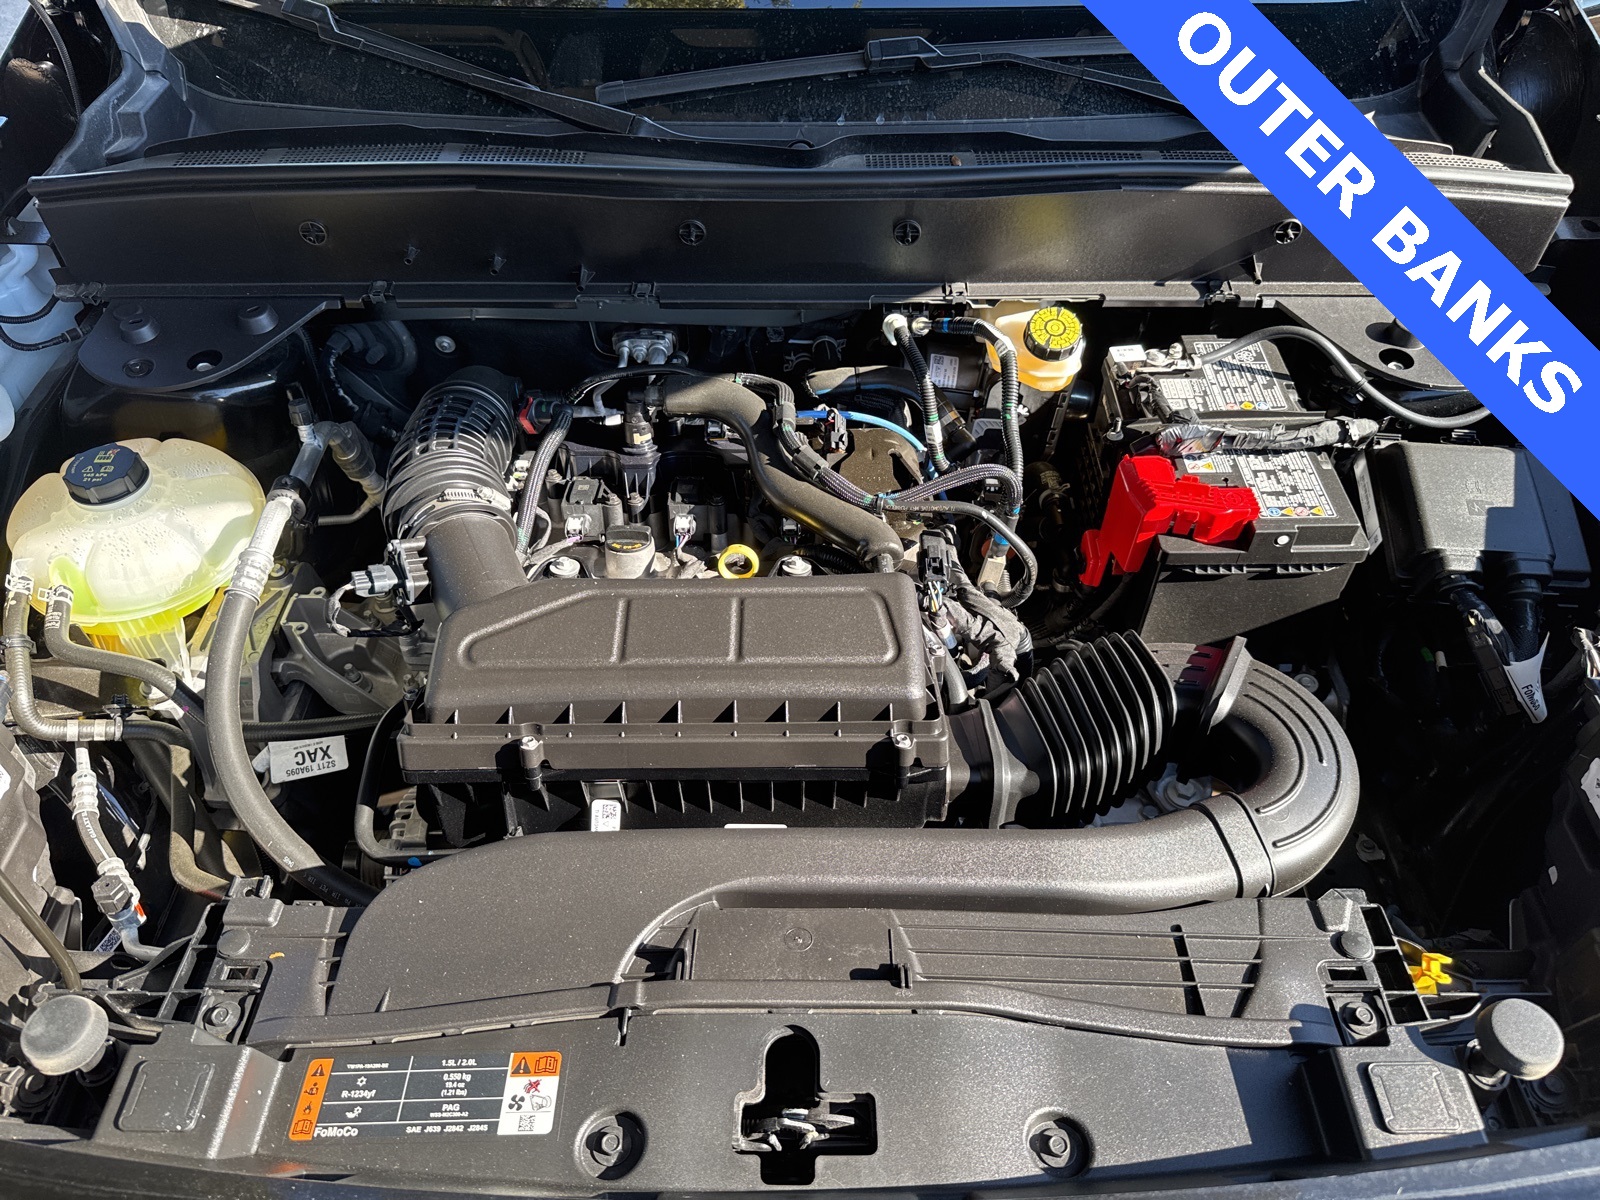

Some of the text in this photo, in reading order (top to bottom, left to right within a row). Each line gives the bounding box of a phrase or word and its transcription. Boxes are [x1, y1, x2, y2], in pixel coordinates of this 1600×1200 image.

[294, 745, 332, 766] XAC
[285, 759, 336, 778] SZ1T 19A095
[443, 1073, 472, 1082] 0.550 kg
[341, 1089, 376, 1099] R-1234yf
[442, 1104, 460, 1112] PAG
[314, 1126, 358, 1138] FoMoCo
[406, 1126, 422, 1134] SAE
